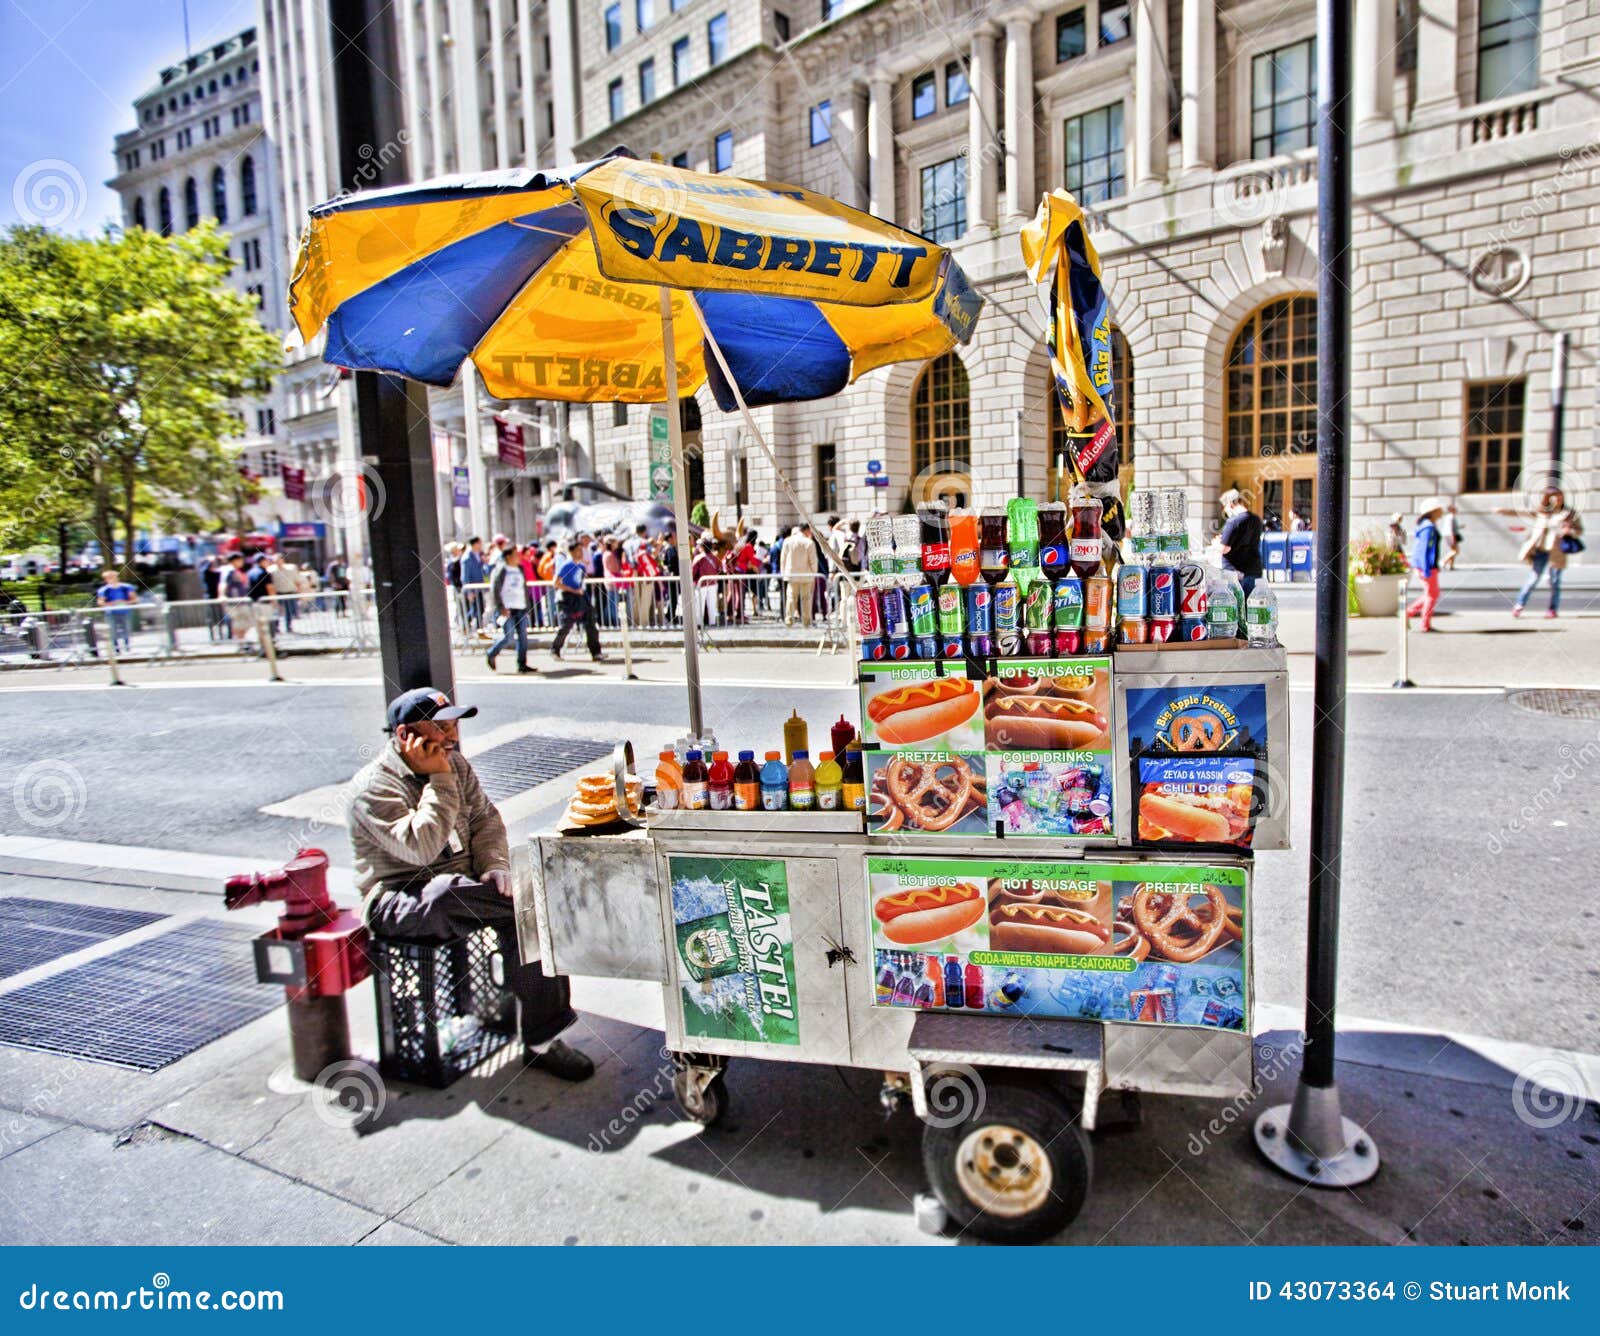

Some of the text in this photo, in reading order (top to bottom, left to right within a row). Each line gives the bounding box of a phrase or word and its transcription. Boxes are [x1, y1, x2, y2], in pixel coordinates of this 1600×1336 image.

[602, 200, 927, 288] SABRETT
[1074, 545, 1099, 557] Coke
[892, 668, 950, 680] HOT DG
[997, 665, 1093, 678] HOT SAUSAGE
[1156, 695, 1236, 727] Big Apple Pretzels
[897, 751, 953, 762] PRETZEL
[1003, 752, 1094, 763] COLD DRINKS
[1163, 770, 1223, 780] ZEYAD & YASSIN
[1163, 783, 1227, 793] CHILI DOG
[899, 875, 957, 887] HOT DOG
[1002, 879, 1096, 891] HOT SAUSAGE
[1145, 882, 1208, 894] PRETZEL
[723, 878, 744, 924] Natural
[732, 925, 753, 973] Spring
[739, 882, 795, 1020] TASTE!
[974, 952, 1131, 971] SODA-WATER-SNAPPLE-GATORADE
